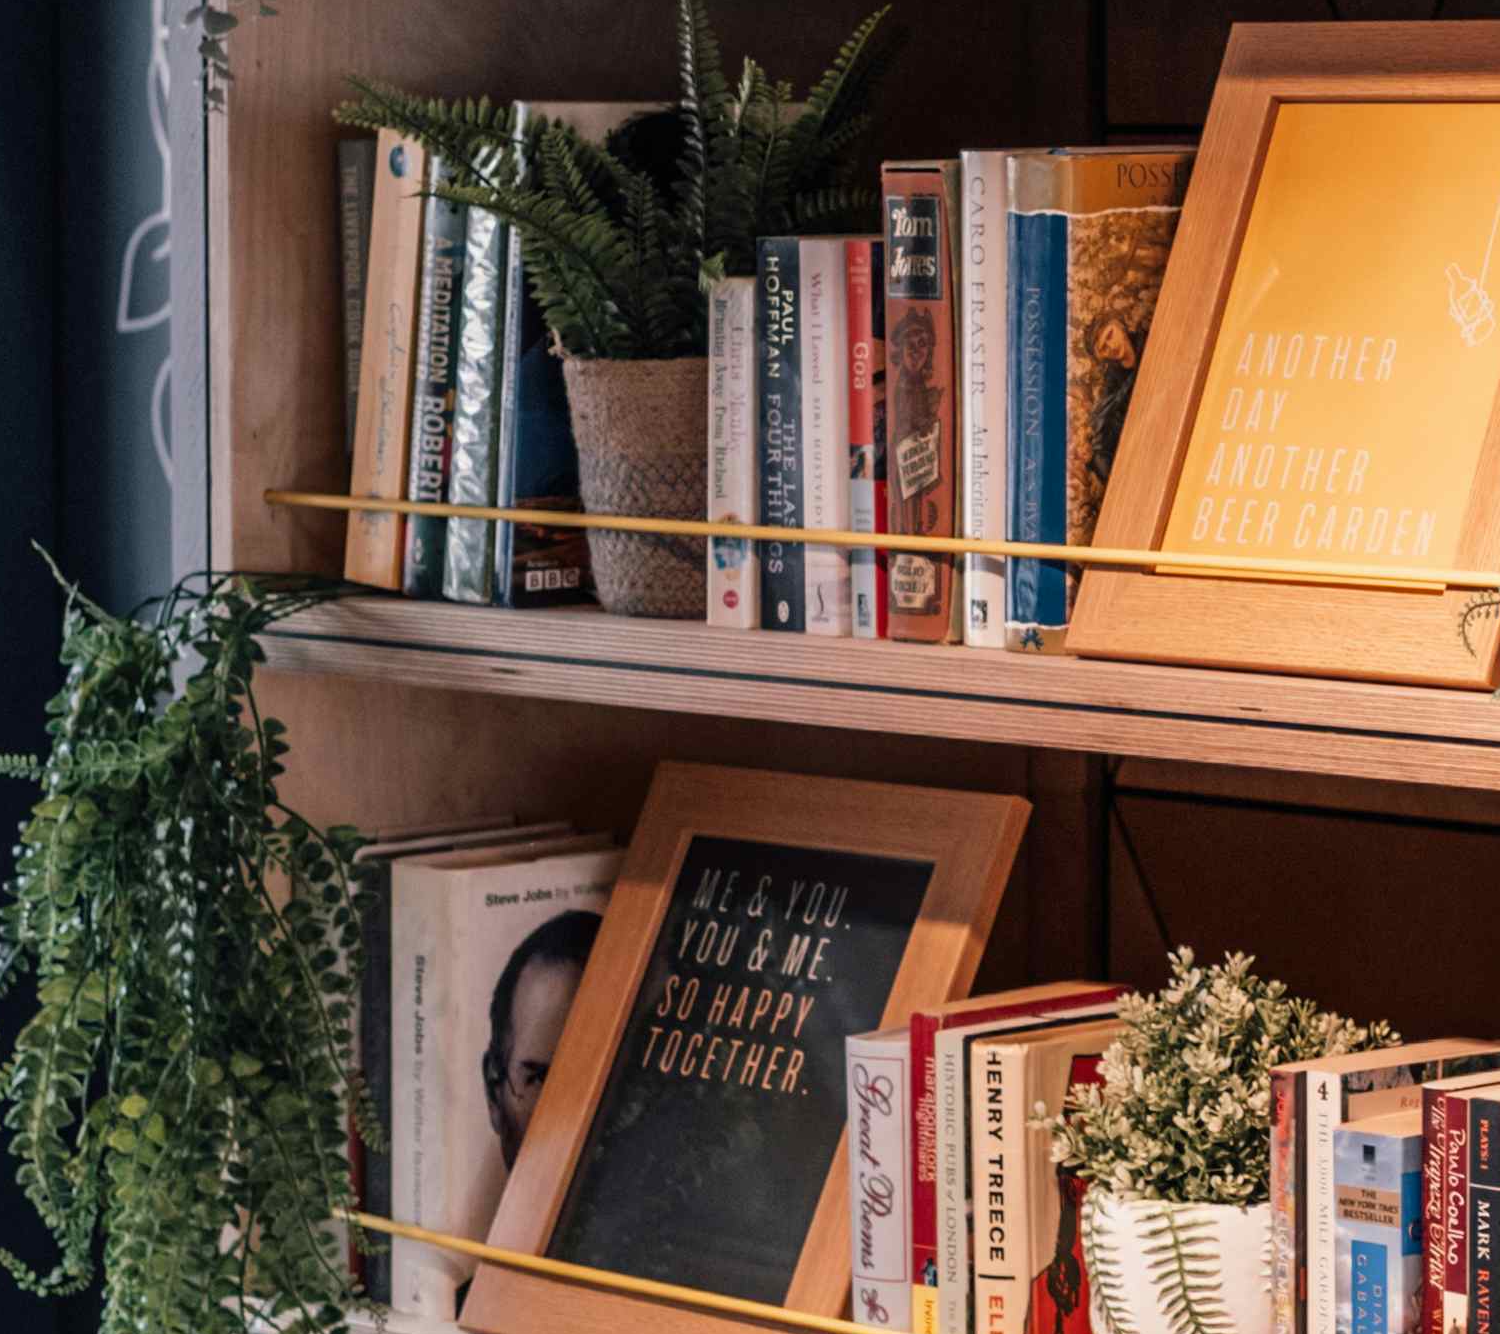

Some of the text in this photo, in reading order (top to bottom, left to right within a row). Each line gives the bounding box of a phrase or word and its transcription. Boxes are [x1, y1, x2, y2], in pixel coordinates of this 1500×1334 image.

[892, 209, 932, 237] Tom
[970, 177, 985, 395] CARO FRASER
[428, 258, 451, 384] MEDITATION
[765, 257, 780, 379] HOFFMAN
[781, 289, 794, 345] PAUL
[853, 342, 869, 390] Goa
[1234, 333, 1398, 383] ANOTHER
[767, 394, 781, 461] FOUR
[1221, 387, 1289, 434] DAY
[783, 420, 796, 471] THE
[1206, 442, 1370, 492] ANOTHER
[1191, 498, 1436, 556] BEER GARDEN
[485, 889, 552, 907] Steve Jobs
[693, 868, 770, 916] ME &
[679, 919, 833, 982] YOU & ME.
[656, 974, 814, 1039] SO HAPPY
[642, 1025, 809, 1096] TOGETHER.
[986, 1050, 1005, 1262] HENRY TREECE
[1342, 1209, 1395, 1225] BESTSELLER
[1475, 1199, 1493, 1260] MARK
